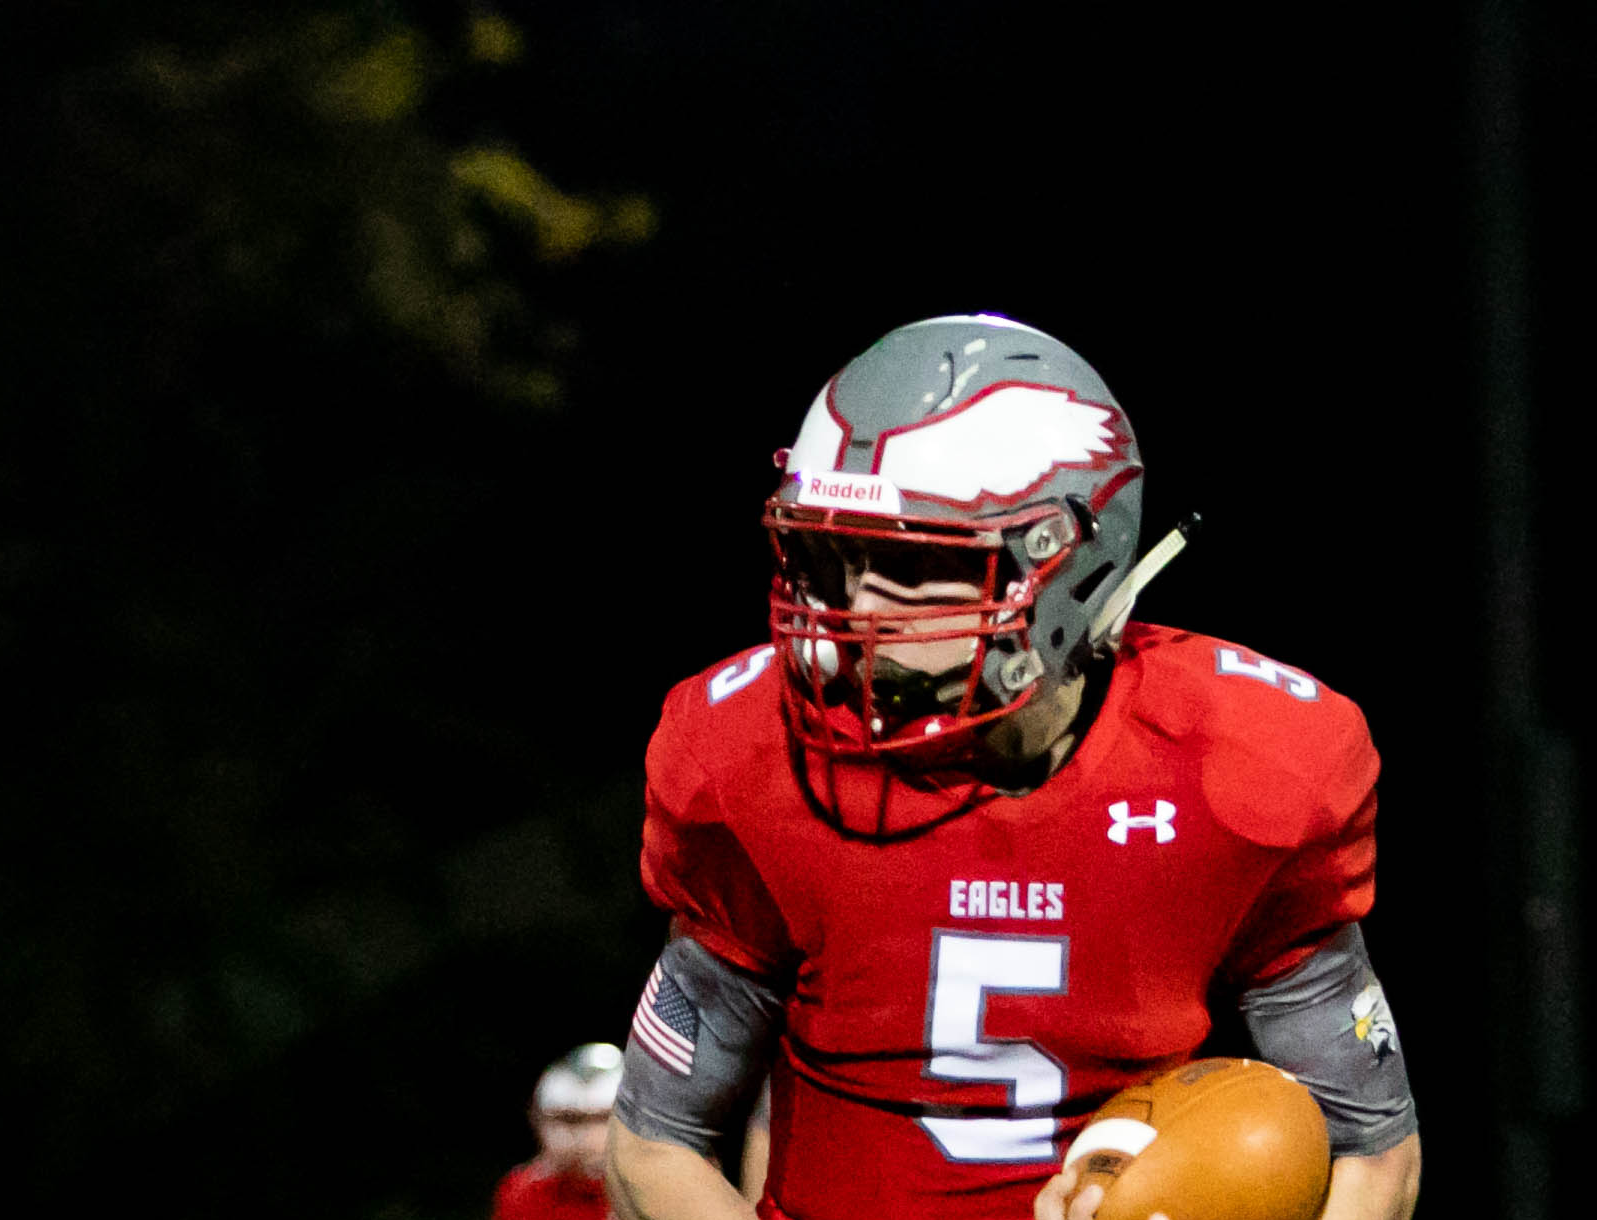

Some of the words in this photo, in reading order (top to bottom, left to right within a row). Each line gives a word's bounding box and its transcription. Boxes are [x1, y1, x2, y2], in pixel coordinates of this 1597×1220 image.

[810, 479, 882, 502] Riddell
[1215, 647, 1319, 702] 5
[949, 879, 1064, 920] EAGLES
[912, 927, 1070, 1164] 5
